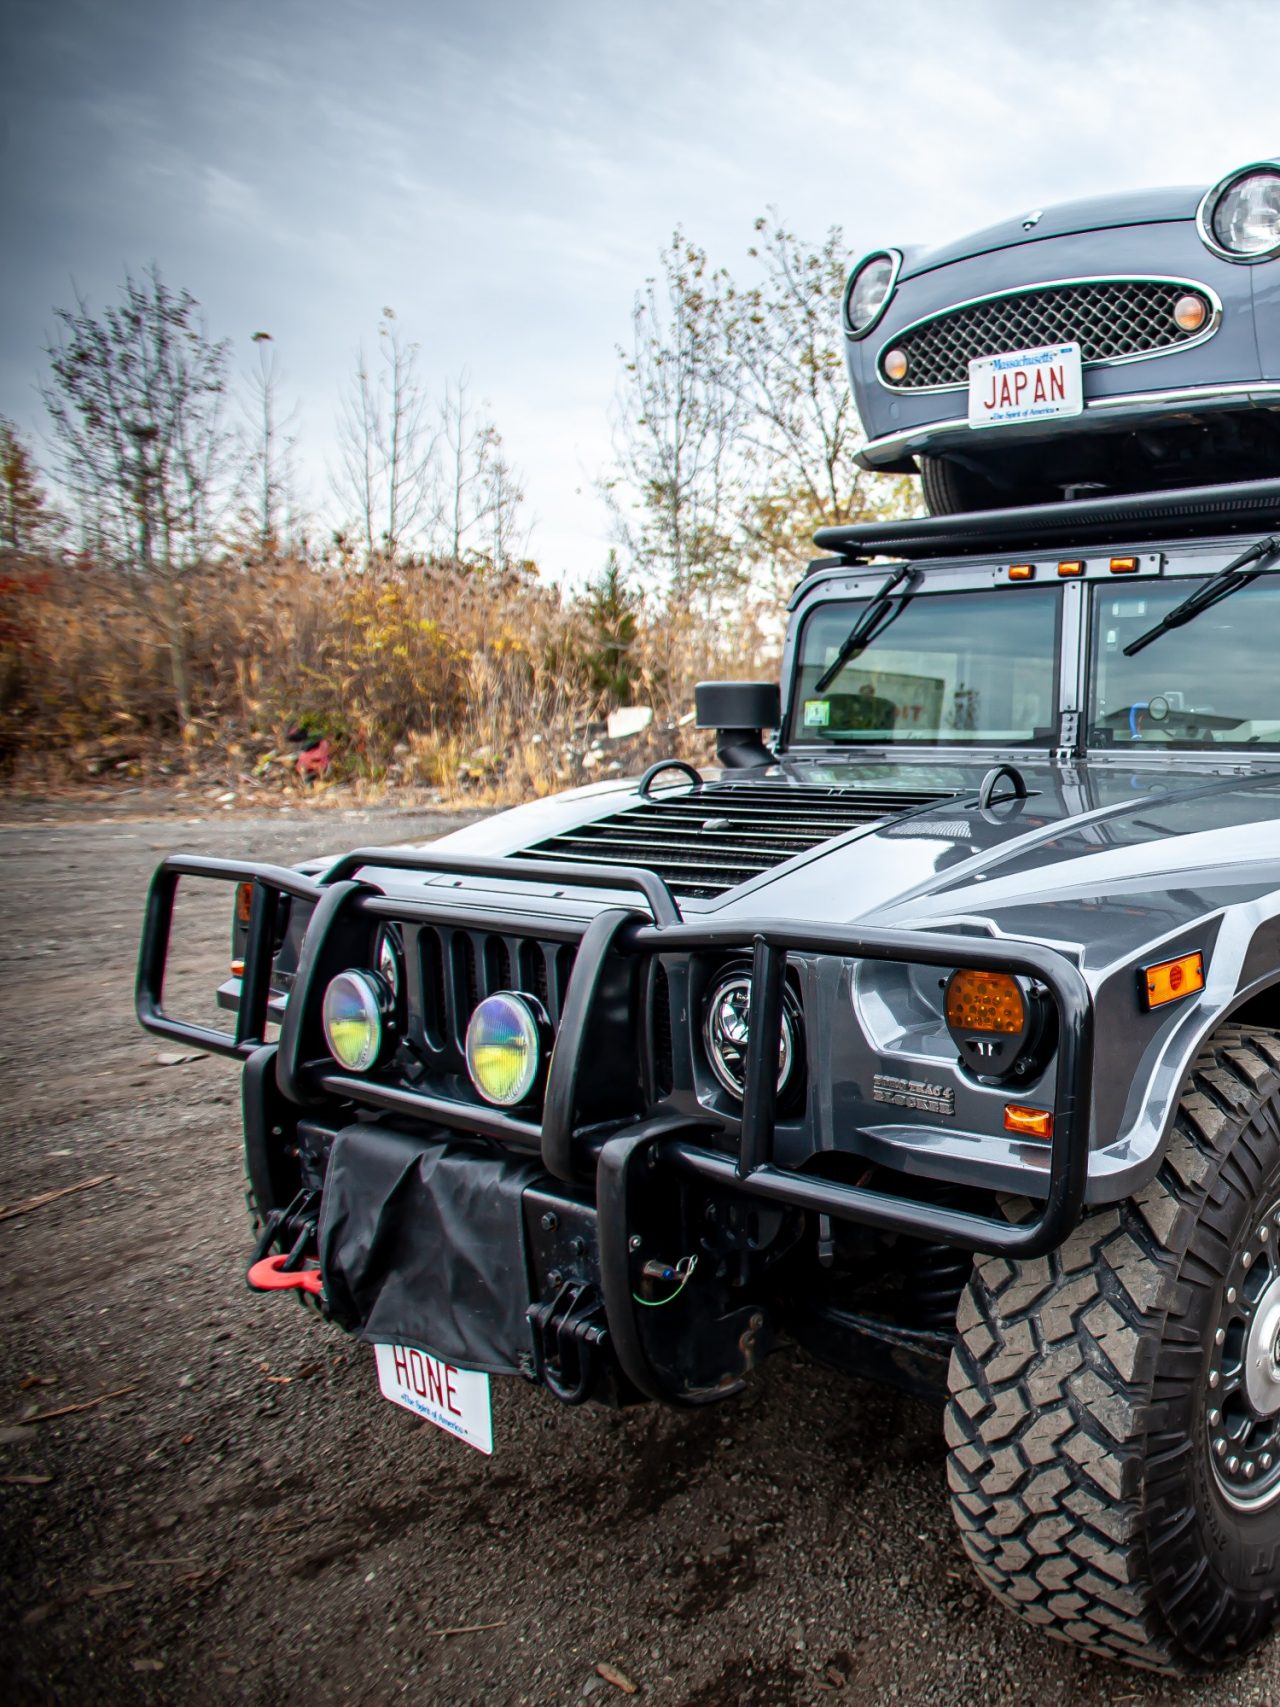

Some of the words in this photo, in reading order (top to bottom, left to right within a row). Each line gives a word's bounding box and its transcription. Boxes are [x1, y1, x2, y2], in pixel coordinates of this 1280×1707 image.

[993, 352, 1053, 370] Massachusetts
[984, 366, 1065, 409] JAPAN
[393, 1344, 462, 1416] HONE
